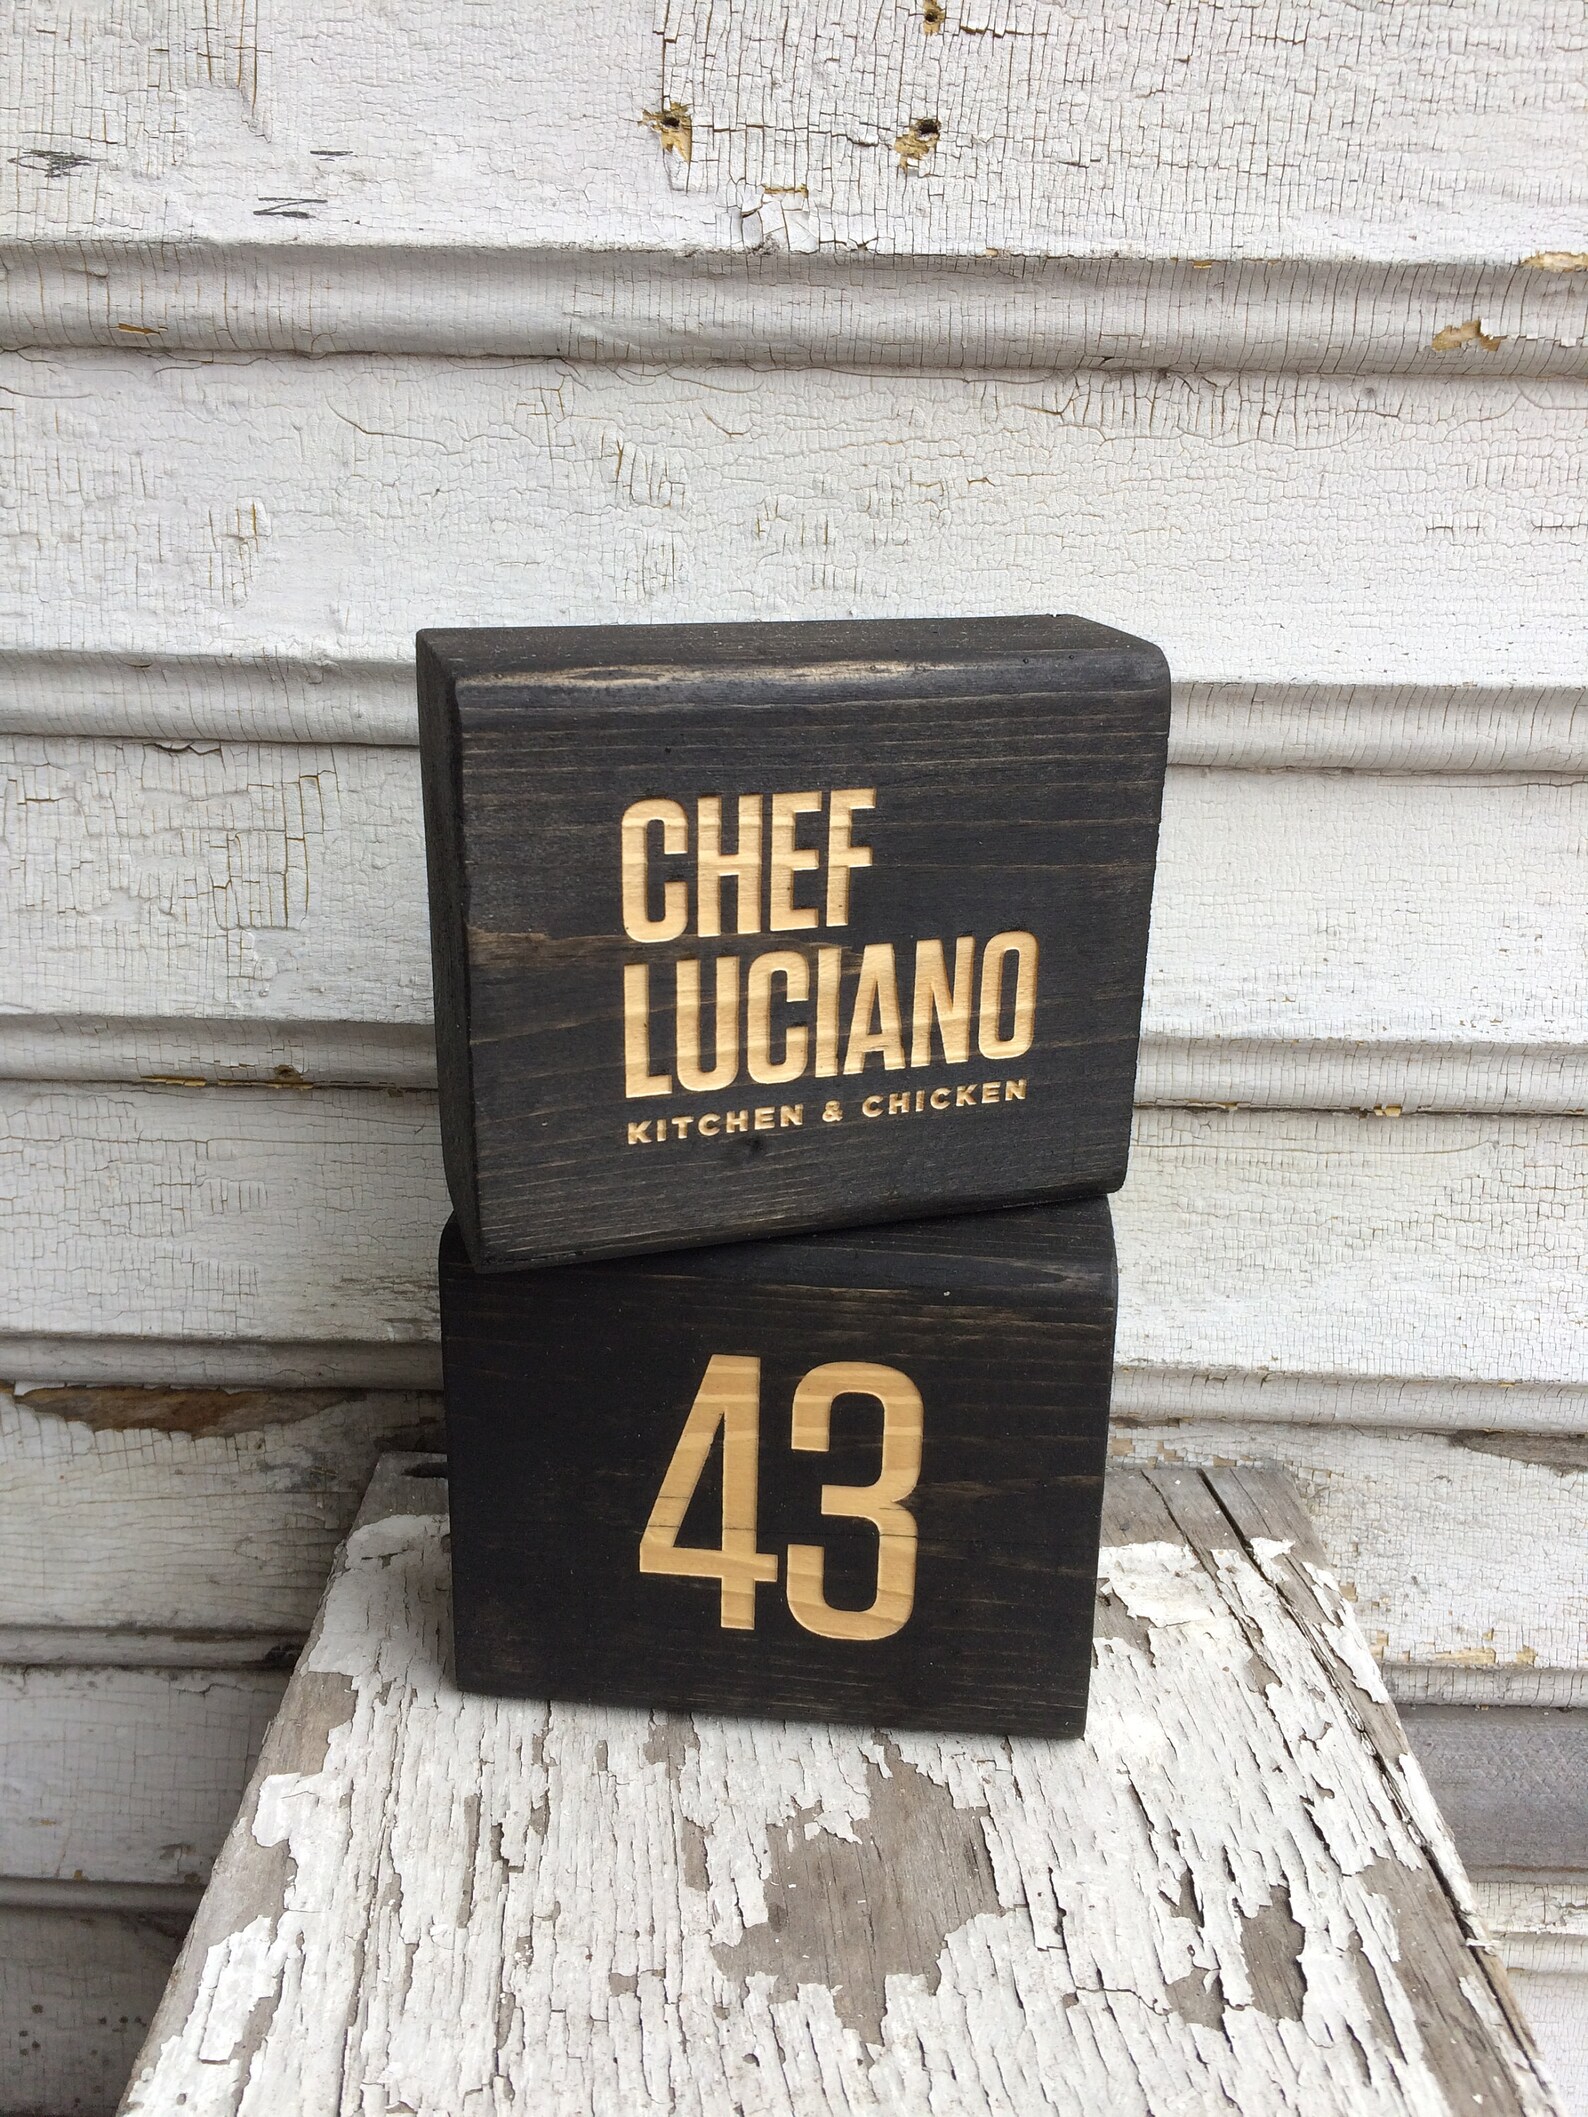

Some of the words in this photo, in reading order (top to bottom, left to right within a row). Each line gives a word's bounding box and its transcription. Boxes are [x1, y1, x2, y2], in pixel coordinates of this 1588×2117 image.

[621, 787, 877, 943] CHEF
[623, 931, 1038, 1098] LUCIANO
[626, 1103, 804, 1145] KITCHEN
[821, 1100, 843, 1123] &
[861, 1079, 1027, 1118] CHICKEN
[638, 1354, 923, 1641] 43
